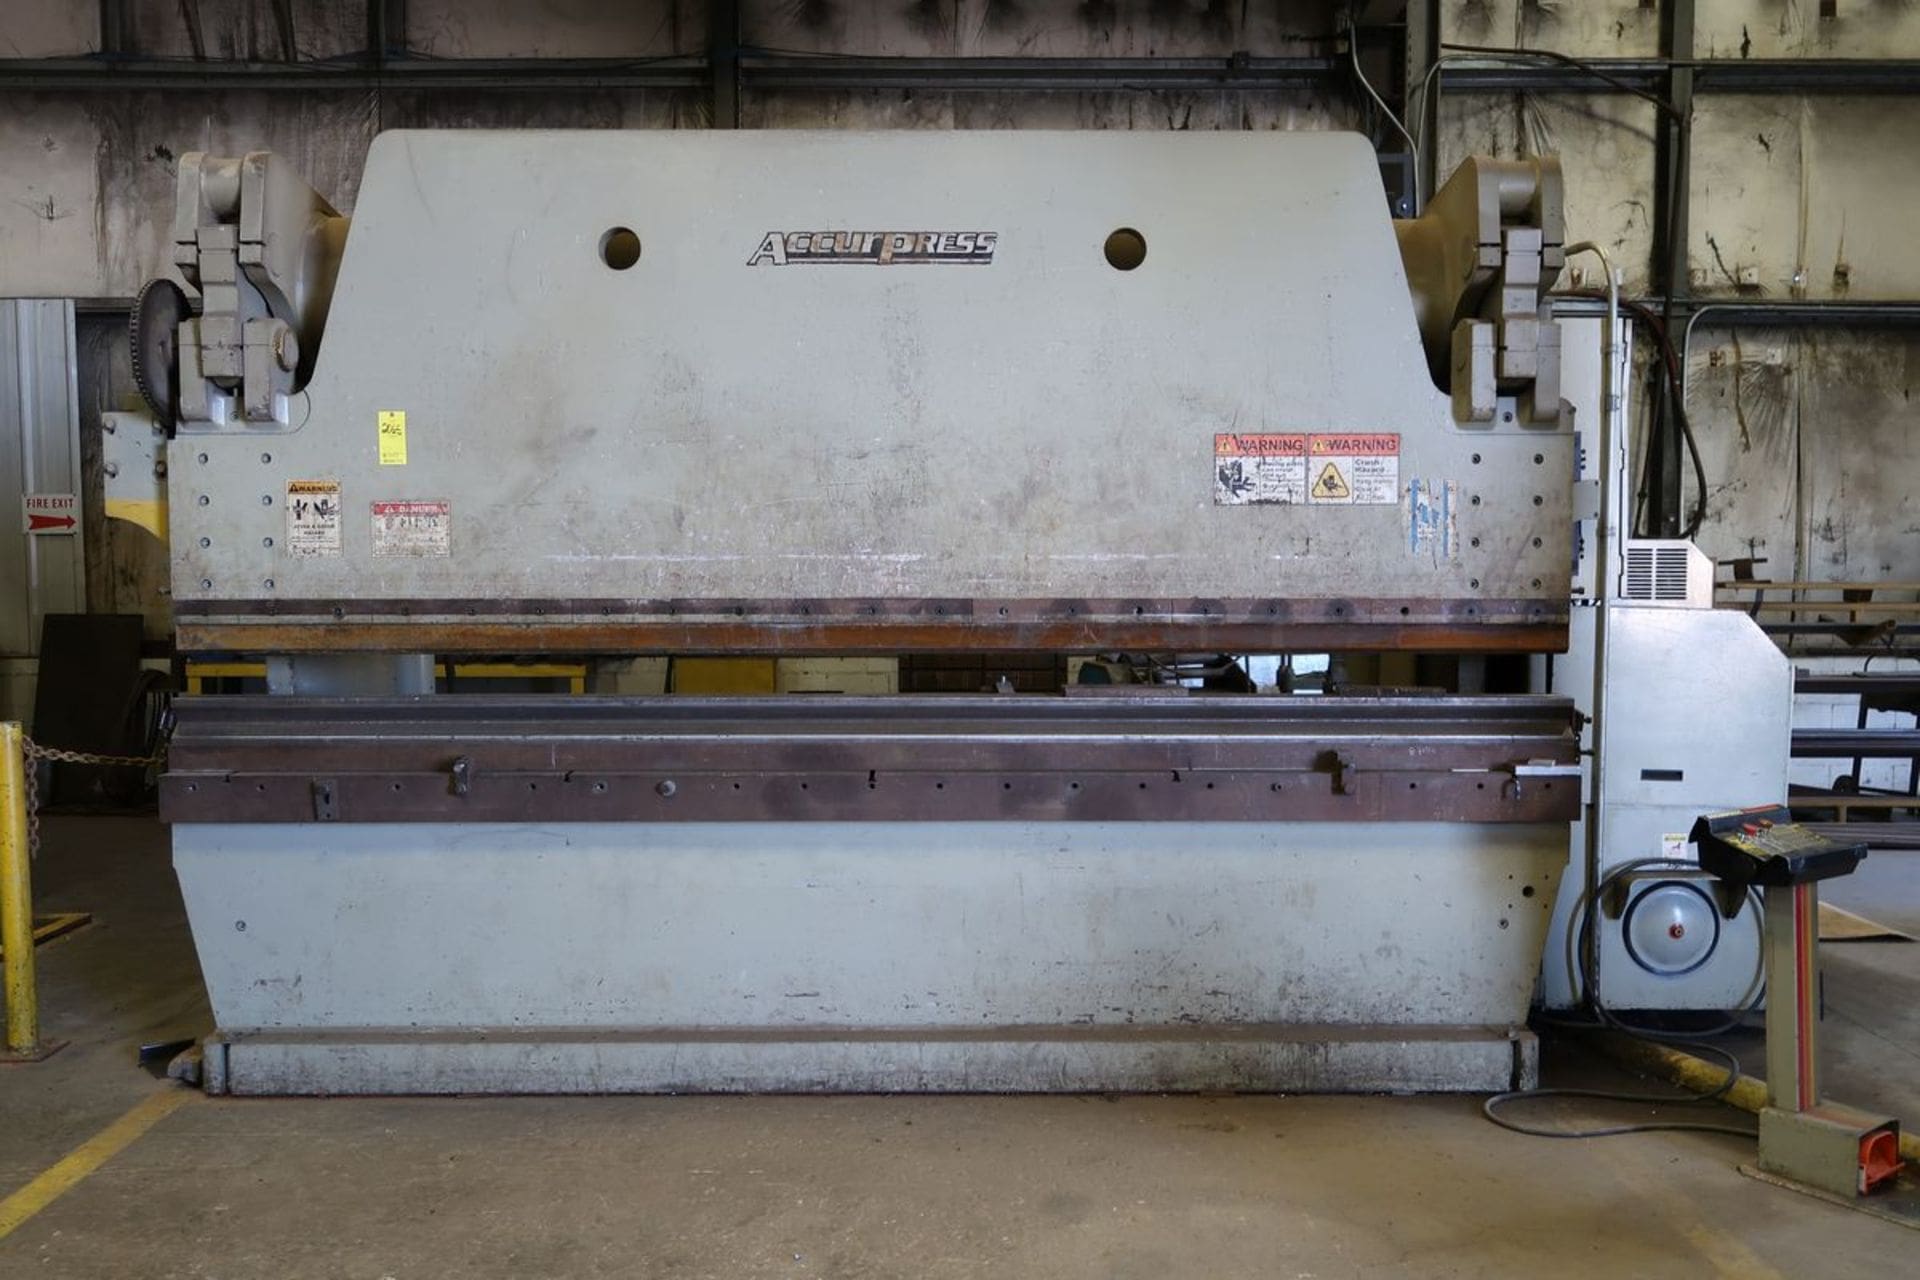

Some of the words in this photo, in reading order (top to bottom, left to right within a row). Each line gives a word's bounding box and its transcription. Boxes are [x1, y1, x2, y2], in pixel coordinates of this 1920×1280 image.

[1237, 439, 1304, 451] WARNING
[1328, 439, 1397, 451] WARNING
[26, 498, 49, 509] FIRE
[52, 498, 73, 509] EXIT
